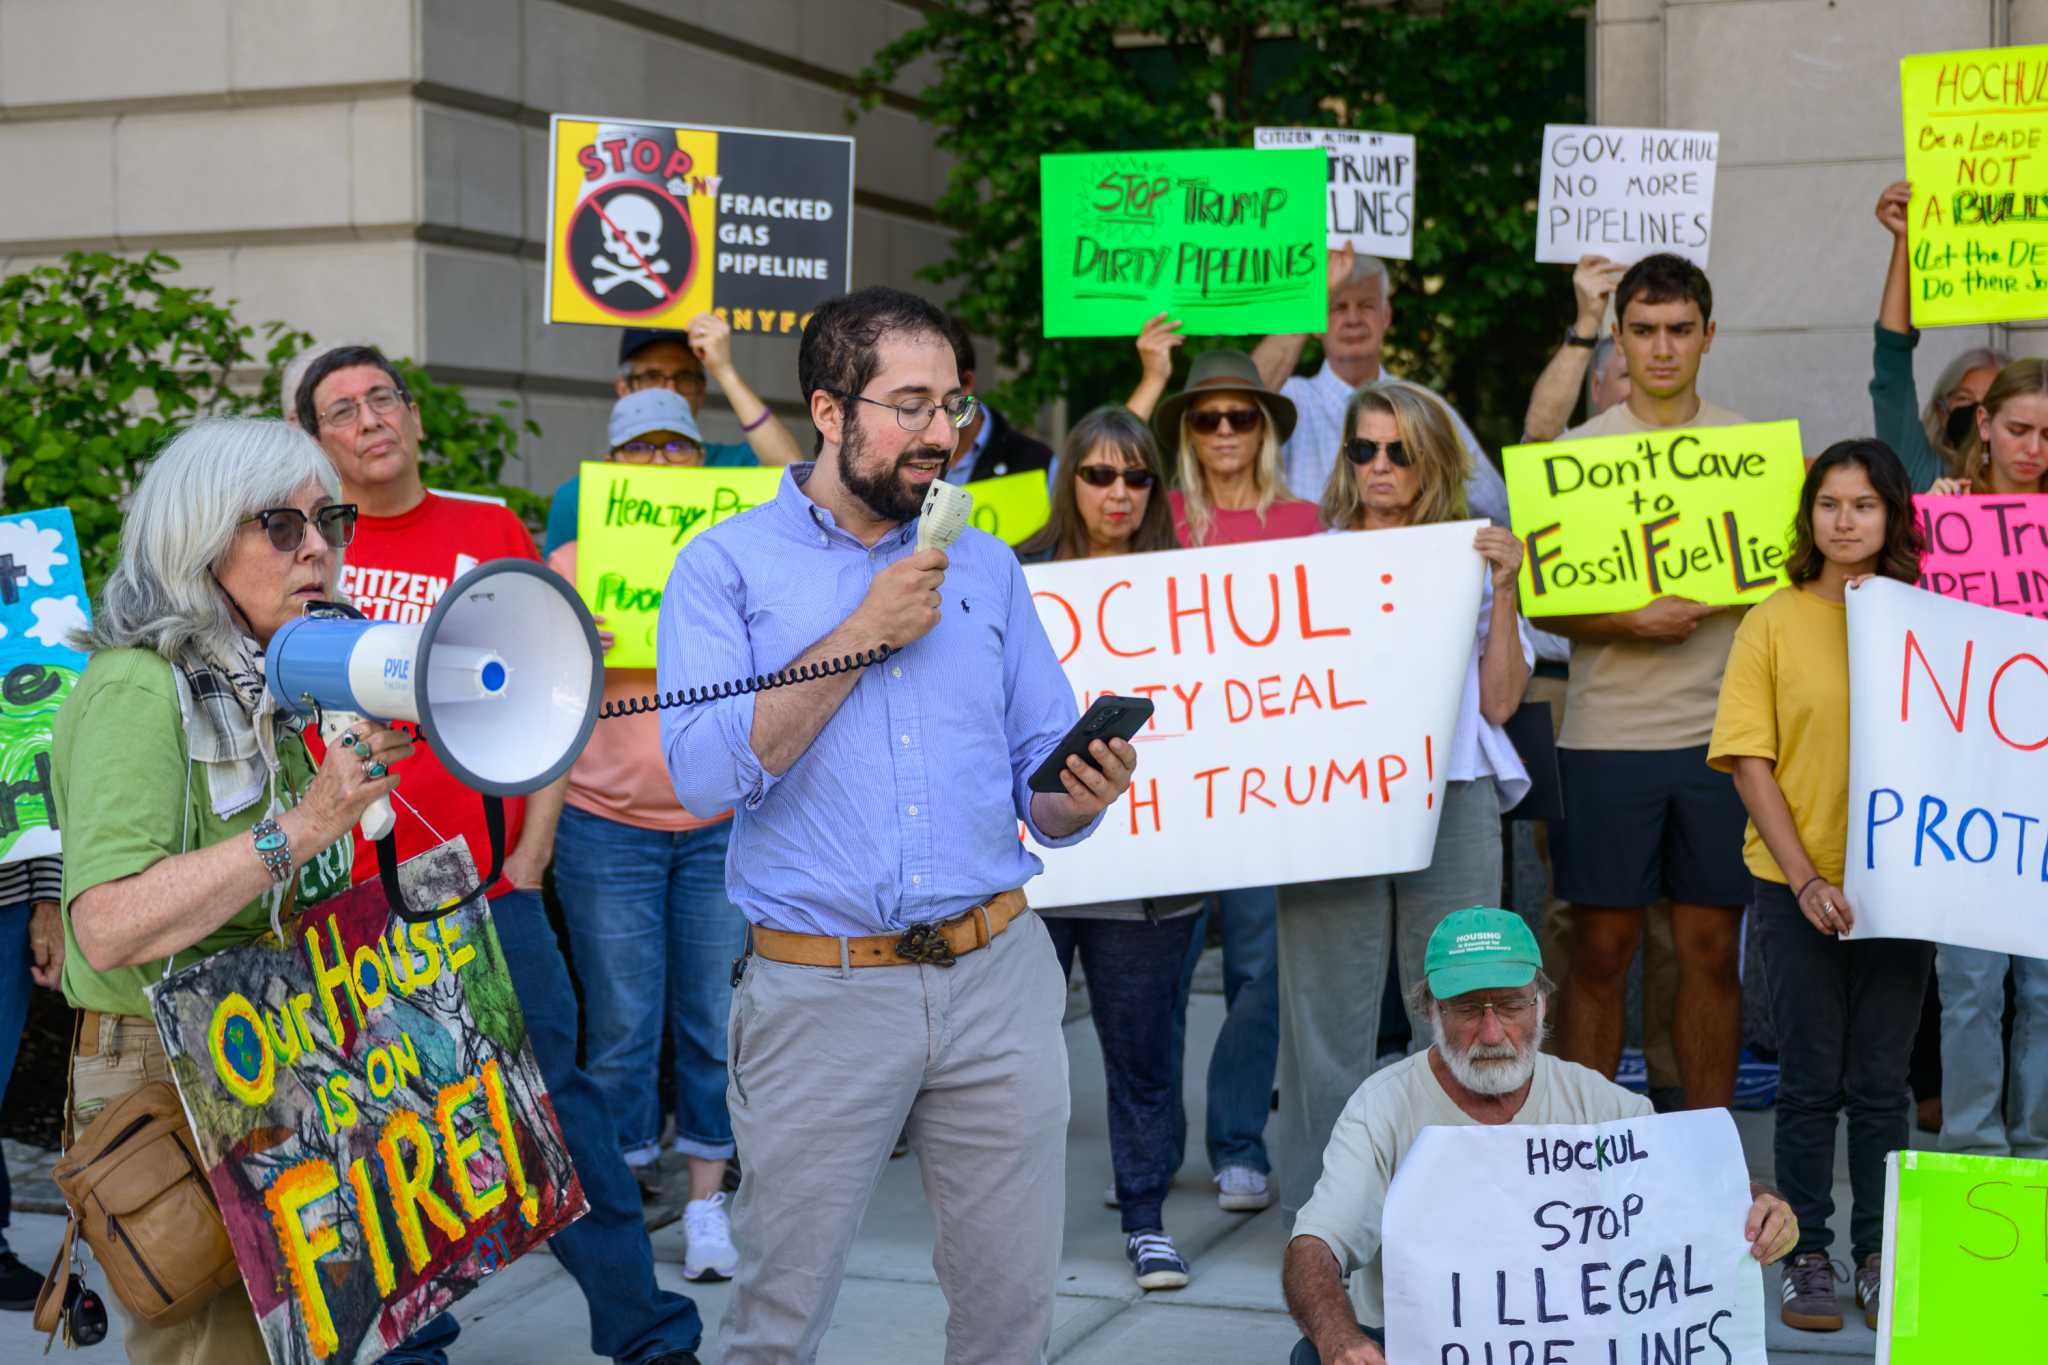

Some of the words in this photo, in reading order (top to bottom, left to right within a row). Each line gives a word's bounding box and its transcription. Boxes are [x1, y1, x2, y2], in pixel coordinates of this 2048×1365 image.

[1260, 128, 1312, 143] CITIZEN
[1552, 134, 1625, 167] GOV.
[1641, 136, 1713, 164] HOCHUL
[577, 138, 693, 181] STOP
[1327, 155, 1409, 186] TRUMP
[1957, 155, 2031, 187] NOT
[1093, 171, 1169, 218] STOP
[1177, 176, 1289, 229] TRUMP
[1554, 174, 1597, 198] NO
[1626, 172, 1700, 196] MORE
[720, 194, 833, 222] FRACKED
[1326, 190, 1411, 237] LINES
[1550, 207, 1708, 248] PIPELINES
[1922, 195, 1944, 229] A
[718, 223, 770, 247] GAS
[717, 252, 829, 280] PIPELINE
[1072, 235, 1171, 288] DIRTY
[1174, 241, 1316, 299] PIPELINES
[1923, 278, 1954, 301] Do
[1543, 440, 1661, 496] Don't
[1668, 436, 1767, 480] Cave
[1628, 490, 1675, 515] to
[1525, 522, 1638, 597] Fossil
[1641, 512, 1725, 595] Fuel
[337, 563, 448, 607] CITIZEN
[342, 595, 434, 625] CTIO
[1030, 563, 1352, 665] OCHUL
[384, 658, 409, 680] PYLE
[1900, 628, 2048, 752] NO
[1224, 668, 1368, 724] DEAL
[1194, 735, 1435, 820] TRUMP!
[1456, 931, 1502, 943] HOUSING
[208, 991, 318, 1107] Our
[313, 1068, 358, 1137] IS
[364, 1031, 422, 1103] ON
[1526, 1128, 1649, 1176] HOCKUL
[264, 1057, 540, 1360] FIRE!
[1533, 1193, 1644, 1252] STOP
[1451, 1244, 1714, 1328] ILLEGAL
